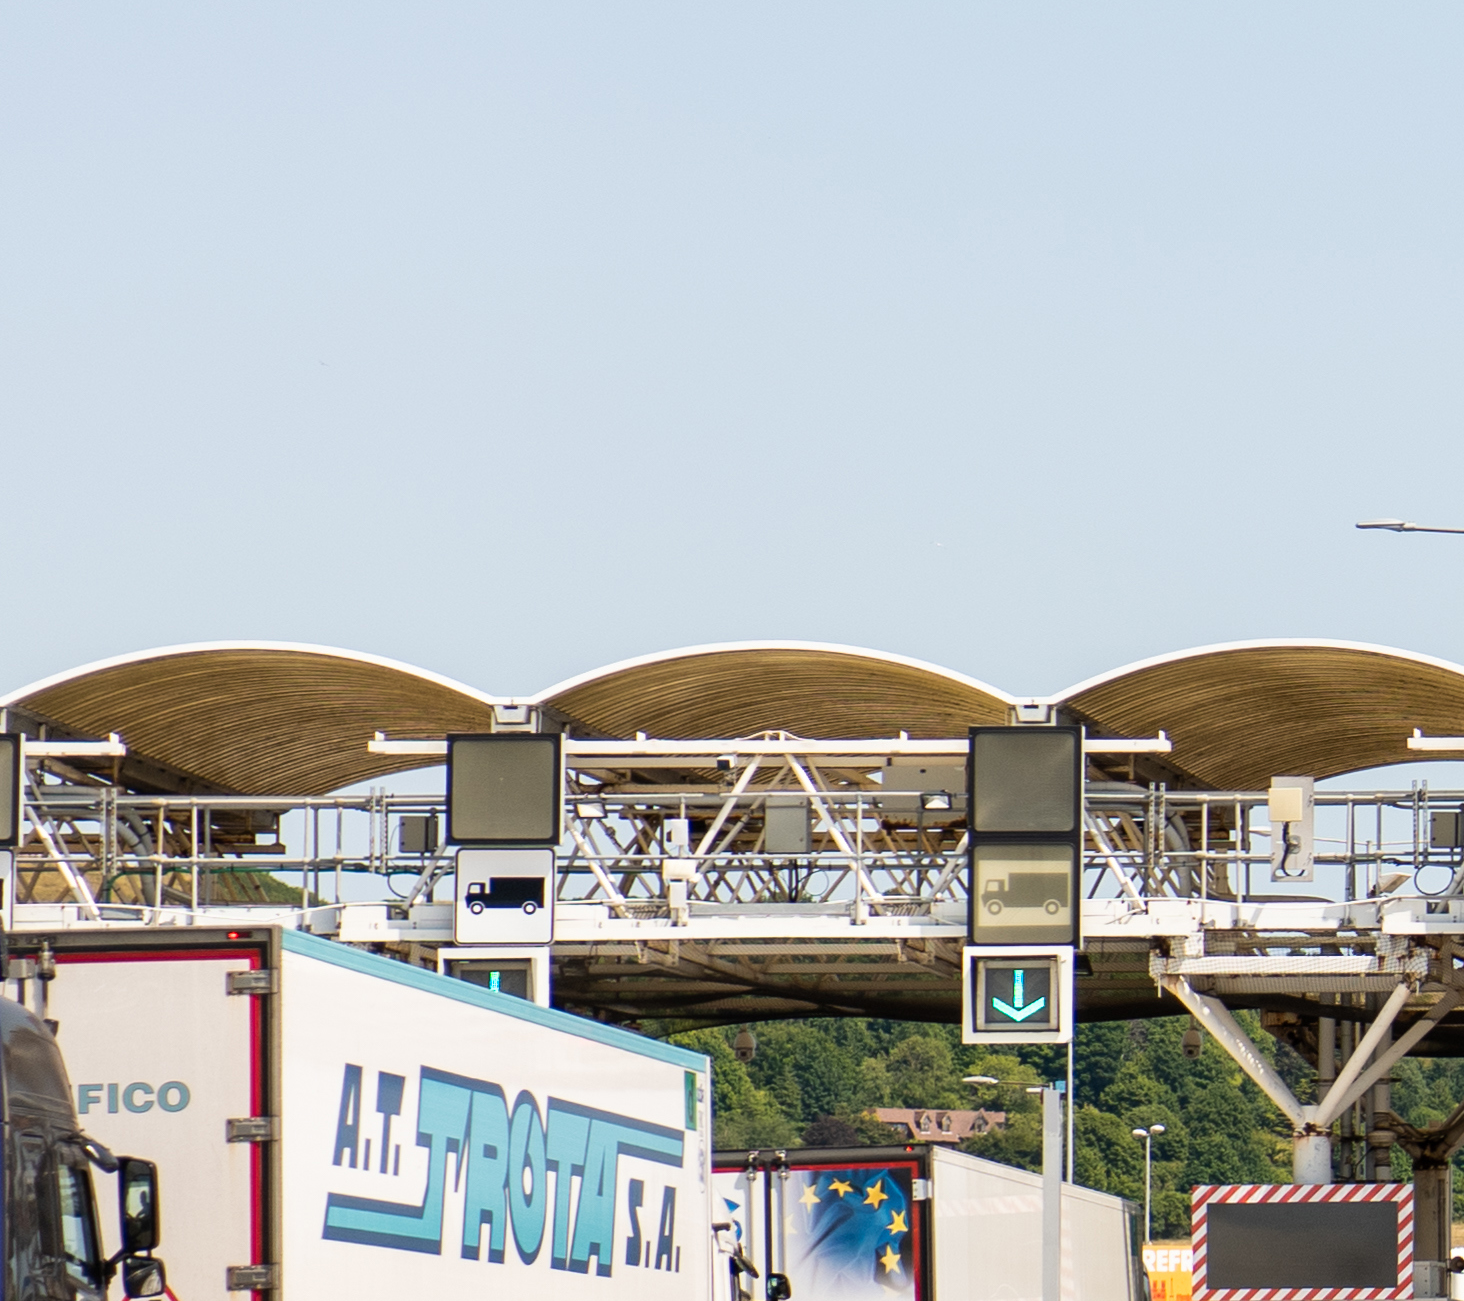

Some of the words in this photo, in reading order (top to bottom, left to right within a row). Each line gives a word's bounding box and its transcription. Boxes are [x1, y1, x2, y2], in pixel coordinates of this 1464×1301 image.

[322, 1065, 685, 1278] TROTA
[332, 1063, 406, 1176] A.T.
[625, 1178, 681, 1273] S.A.
